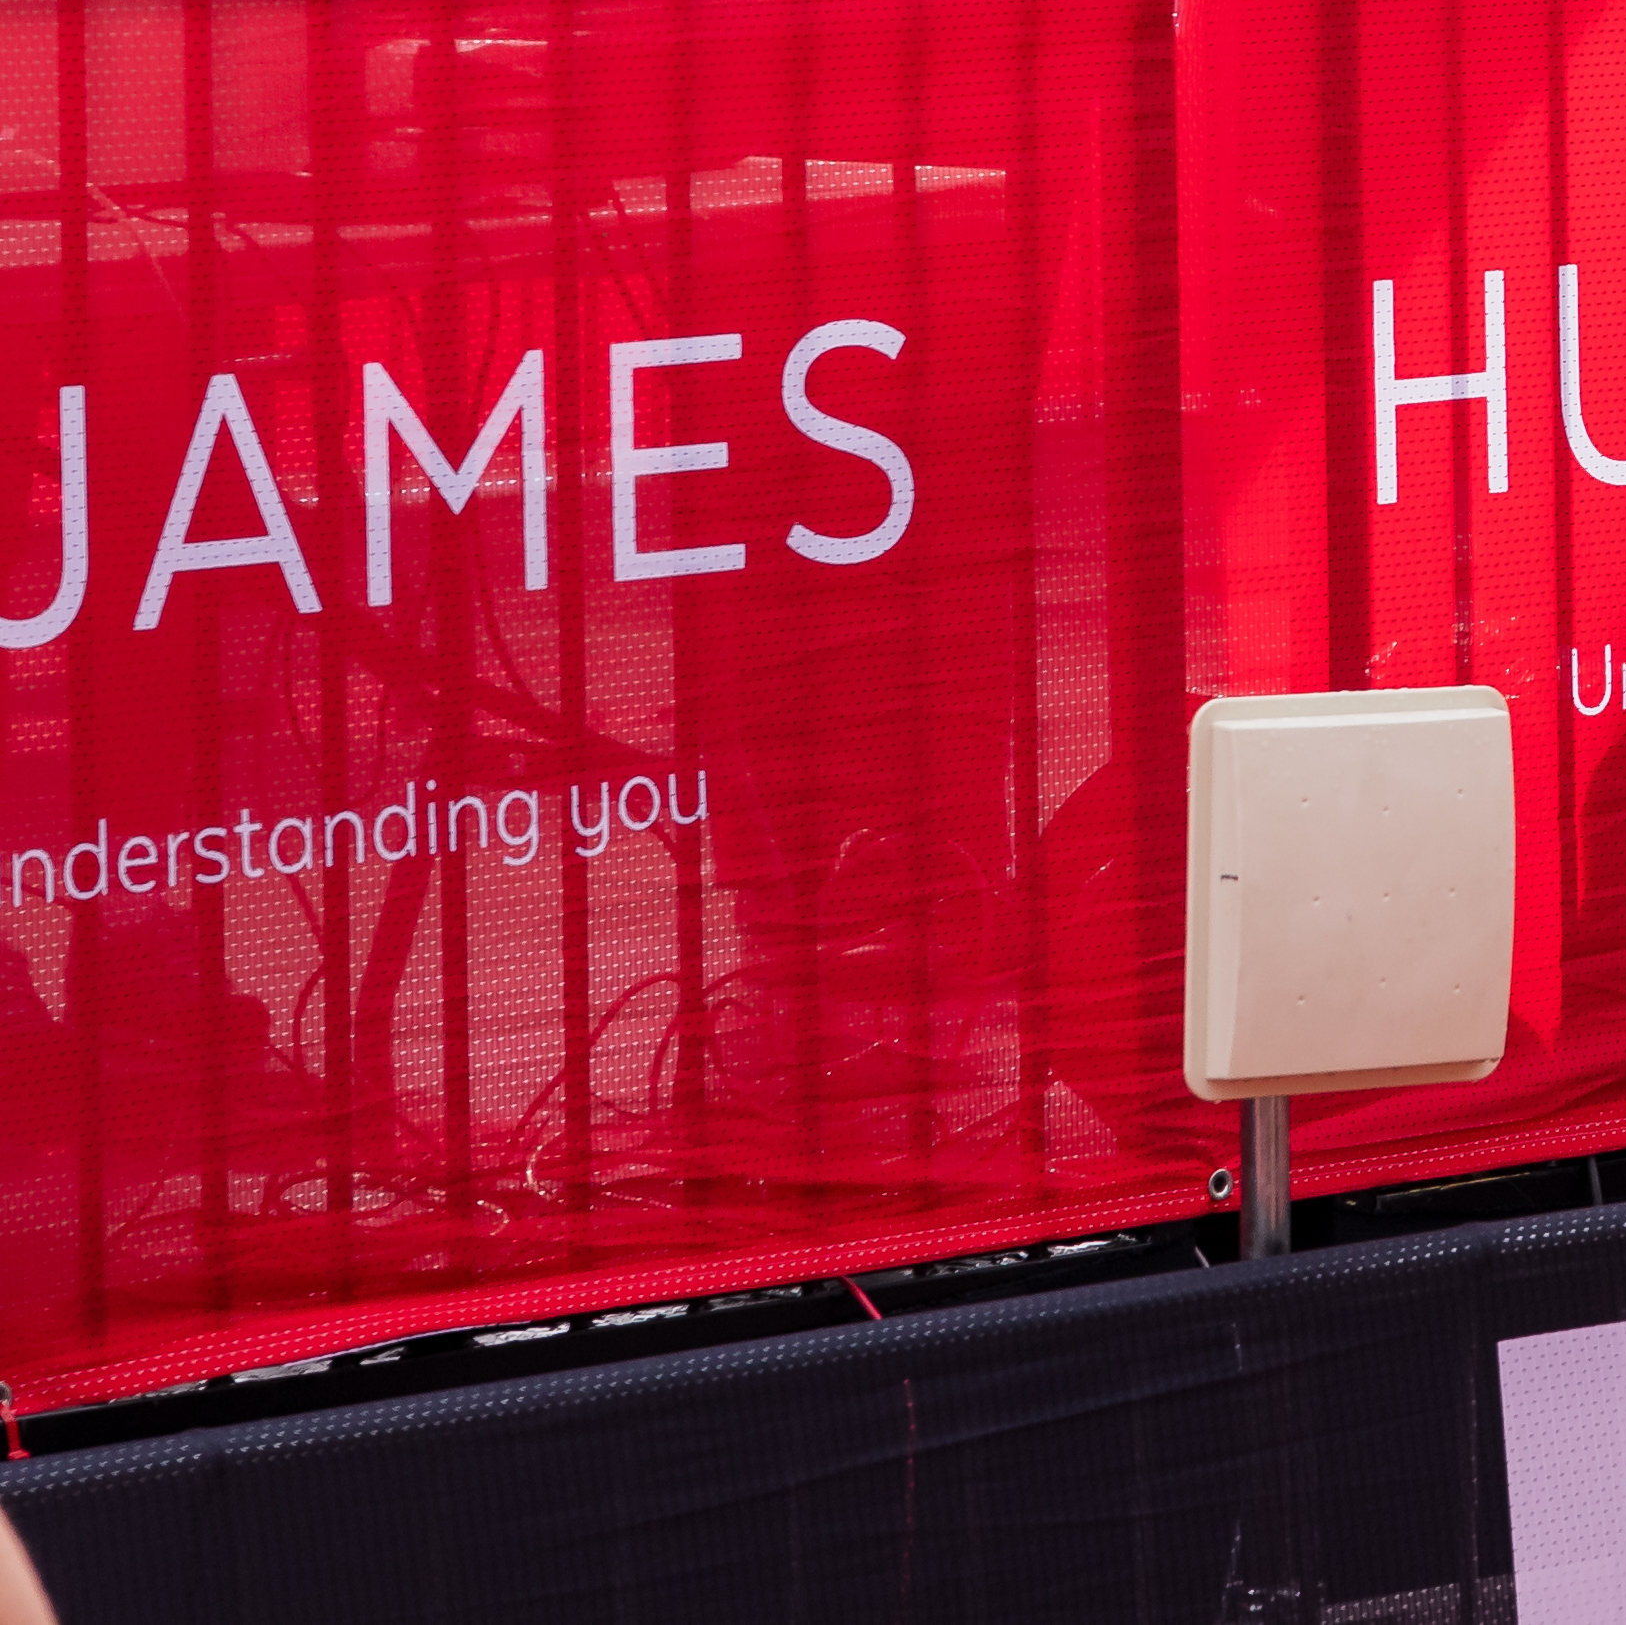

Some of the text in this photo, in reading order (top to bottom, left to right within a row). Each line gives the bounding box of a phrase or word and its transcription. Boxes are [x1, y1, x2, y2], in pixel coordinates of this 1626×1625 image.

[0, 319, 916, 649] JAMES
[0, 771, 709, 908] nderstanding you
